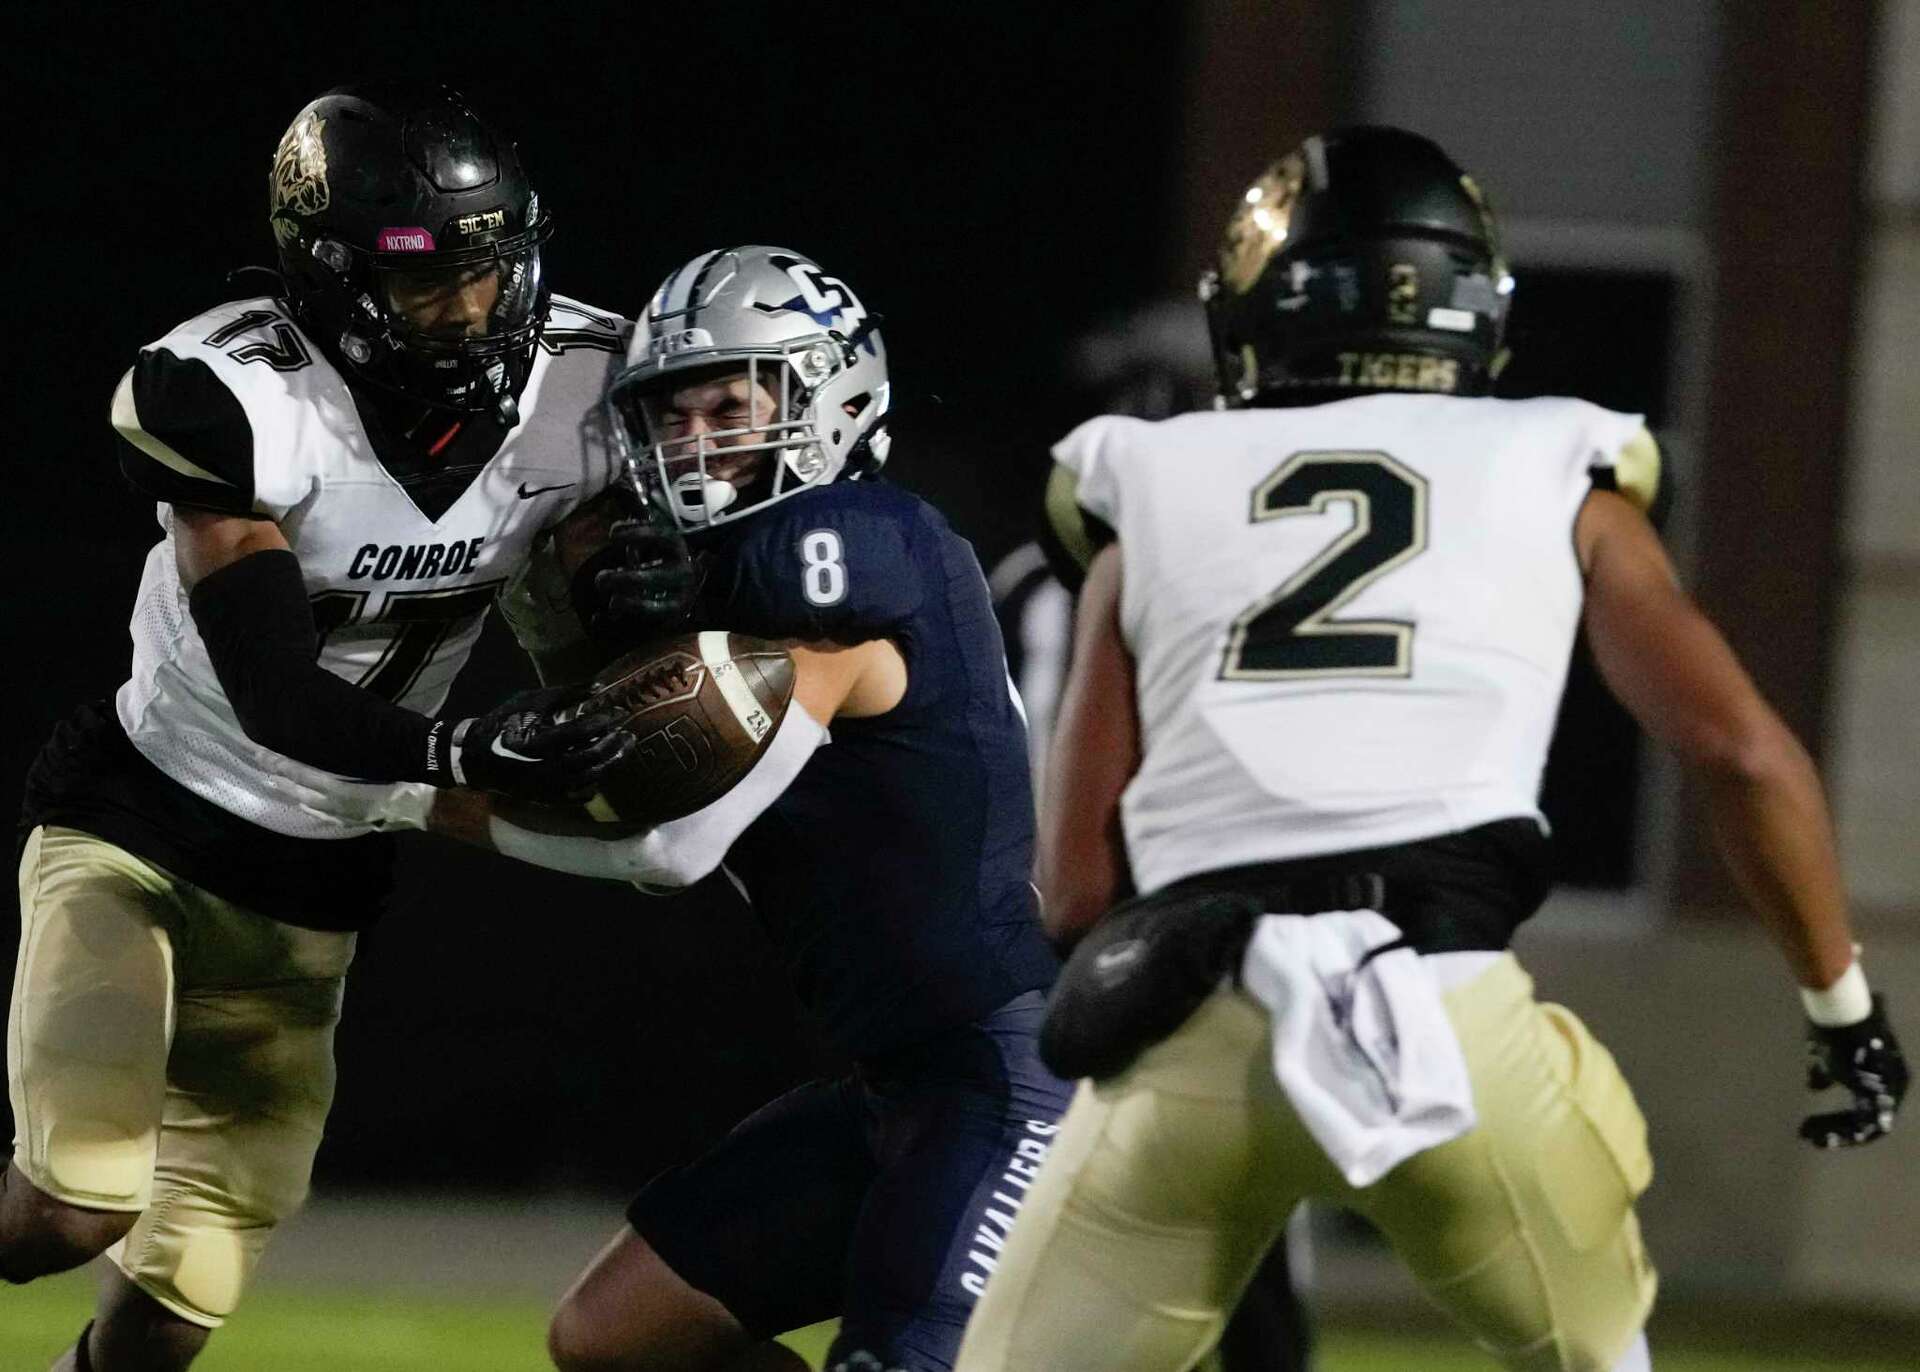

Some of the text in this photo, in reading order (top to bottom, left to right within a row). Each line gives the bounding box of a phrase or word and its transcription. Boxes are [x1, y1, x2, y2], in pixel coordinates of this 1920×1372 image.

[385, 234, 425, 250] NXTRND
[459, 209, 505, 235] SIC 'EM
[1389, 263, 1418, 325] 2
[201, 310, 314, 372] 17
[346, 536, 486, 581] CONROE
[799, 528, 847, 607] 8
[1216, 449, 1429, 682] 2
